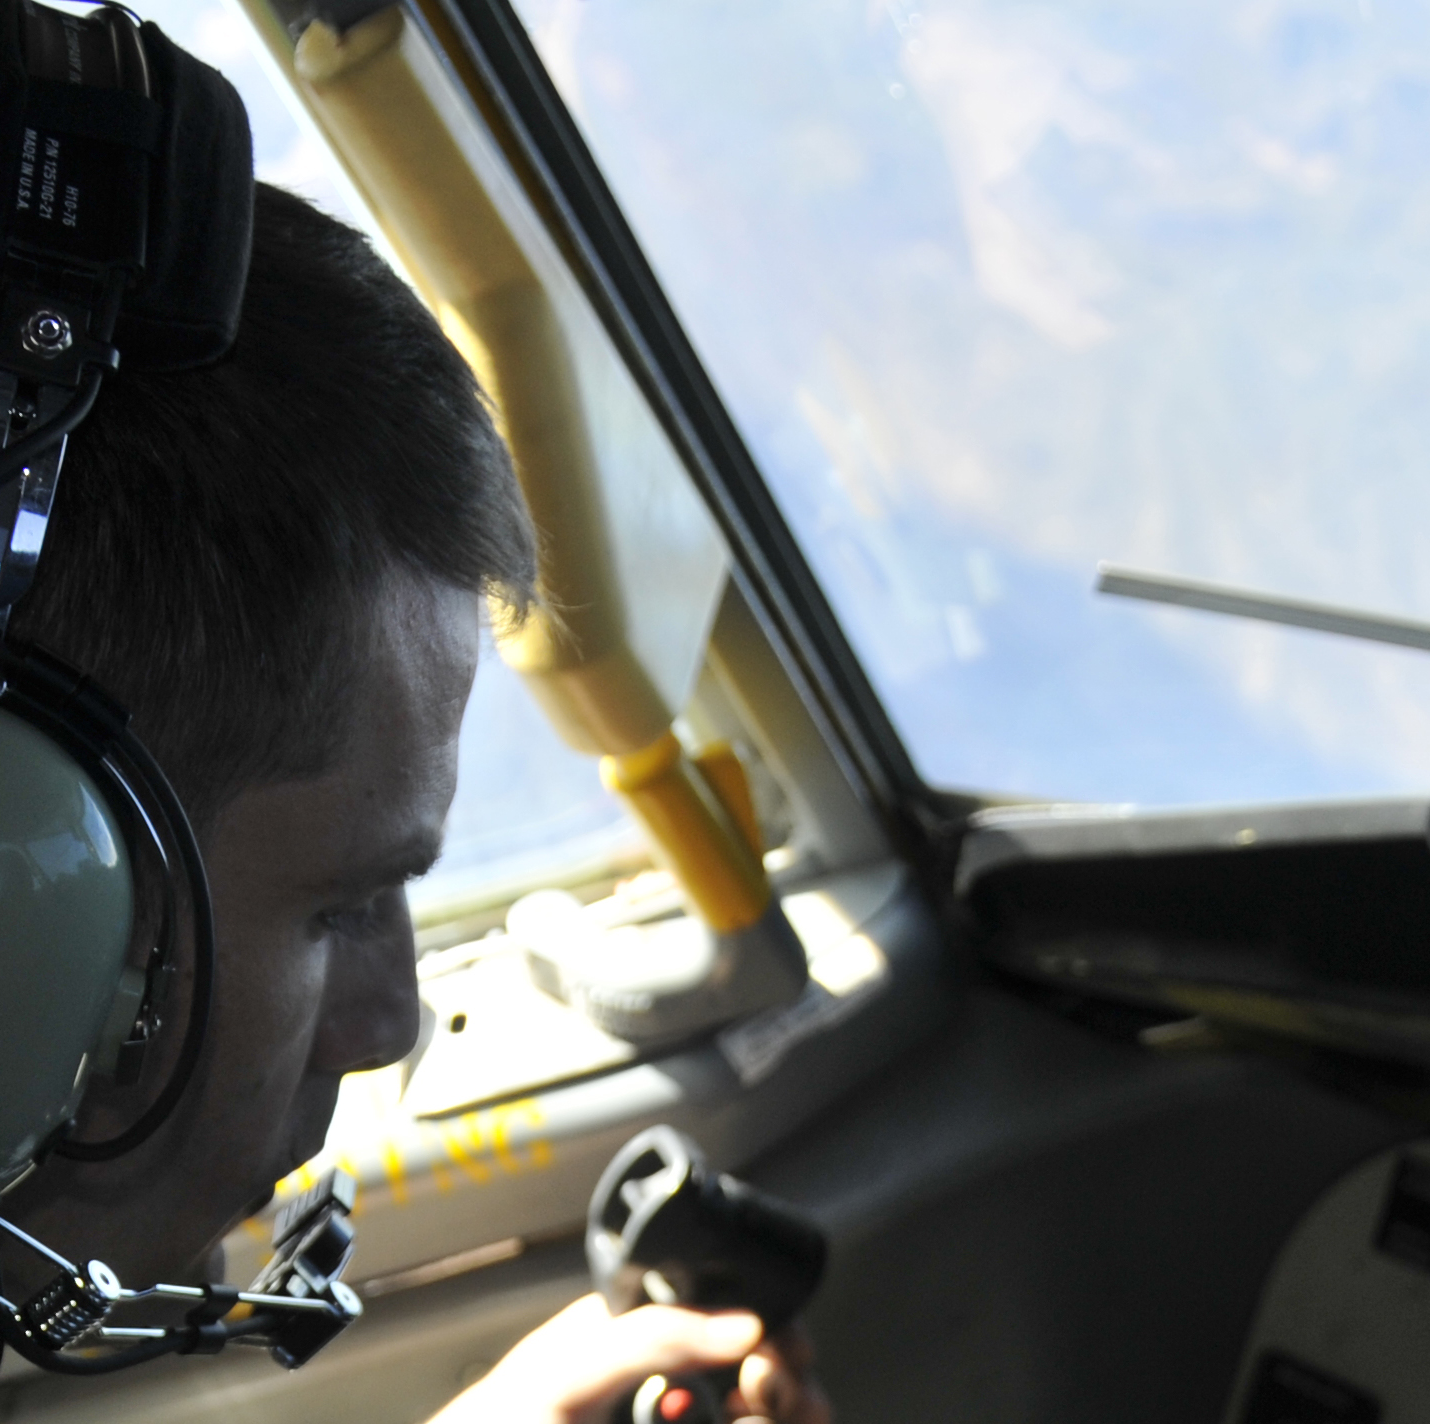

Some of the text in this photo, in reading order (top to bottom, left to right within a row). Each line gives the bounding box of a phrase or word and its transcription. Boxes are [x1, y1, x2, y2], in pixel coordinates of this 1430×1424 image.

[22, 126, 39, 163] MADE
[21, 163, 35, 178] IN
[61, 184, 80, 228] H10-76
